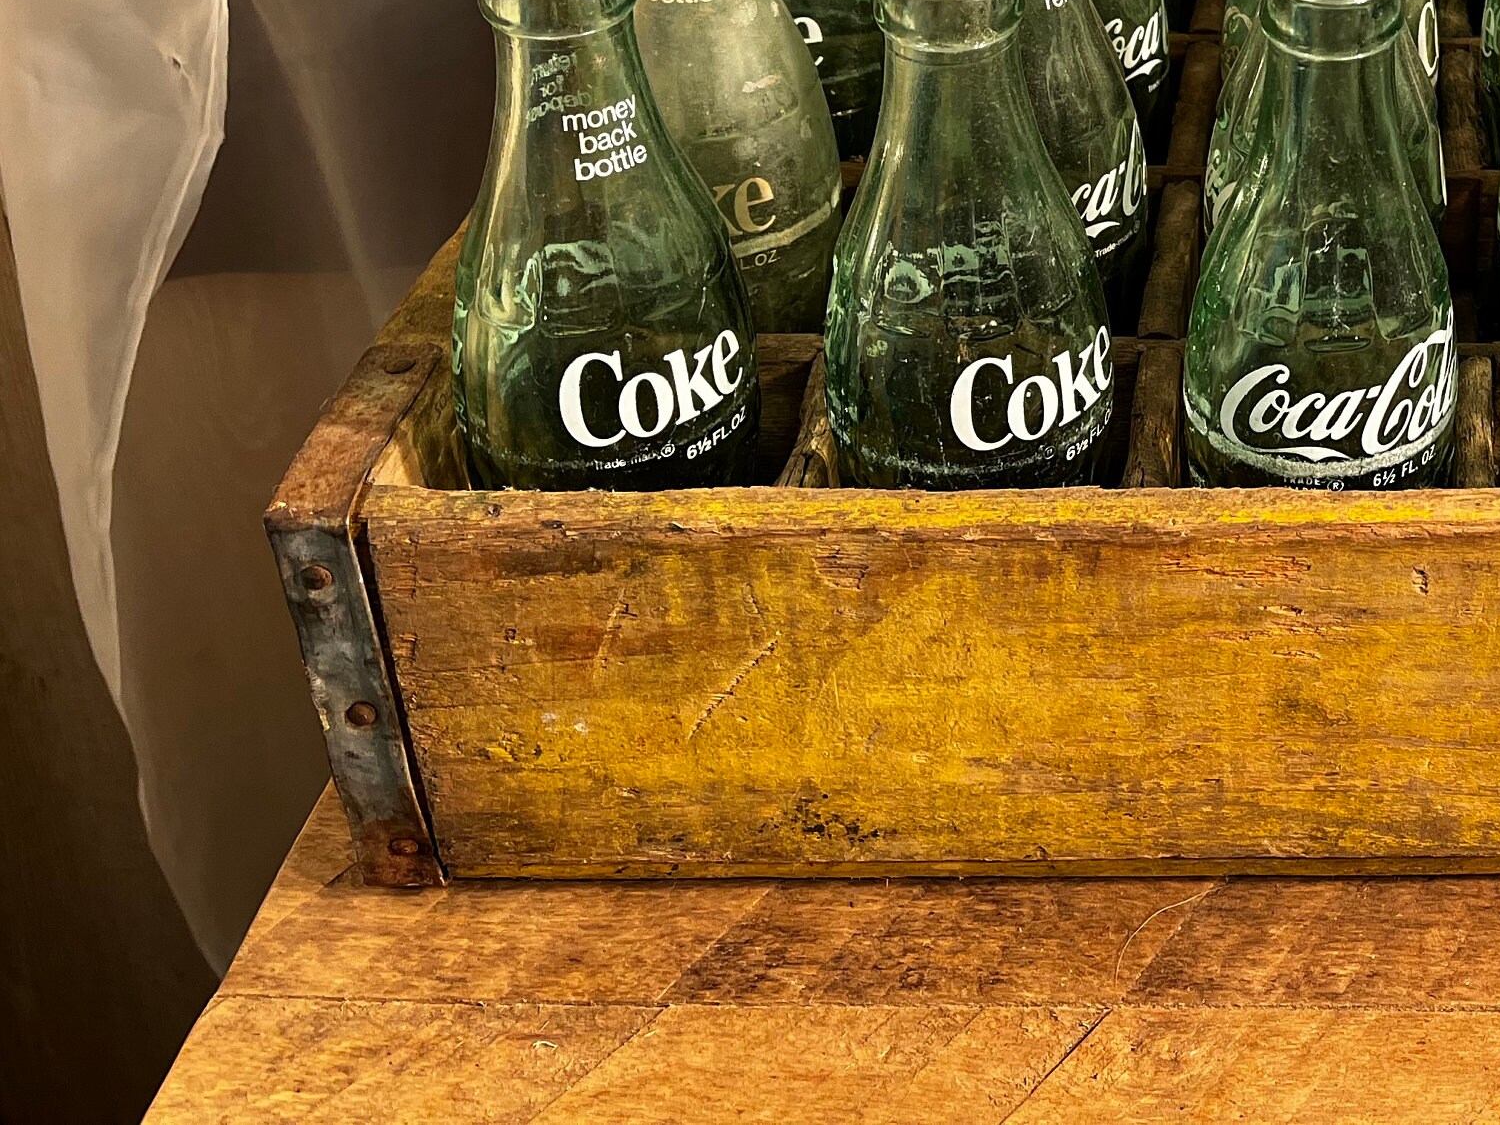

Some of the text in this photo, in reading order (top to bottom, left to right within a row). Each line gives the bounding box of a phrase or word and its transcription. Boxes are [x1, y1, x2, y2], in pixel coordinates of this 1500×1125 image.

[561, 94, 636, 132] money
[578, 120, 638, 155] back
[573, 144, 648, 181] bottle
[559, 329, 743, 448] Coke
[950, 325, 1113, 451] Coke
